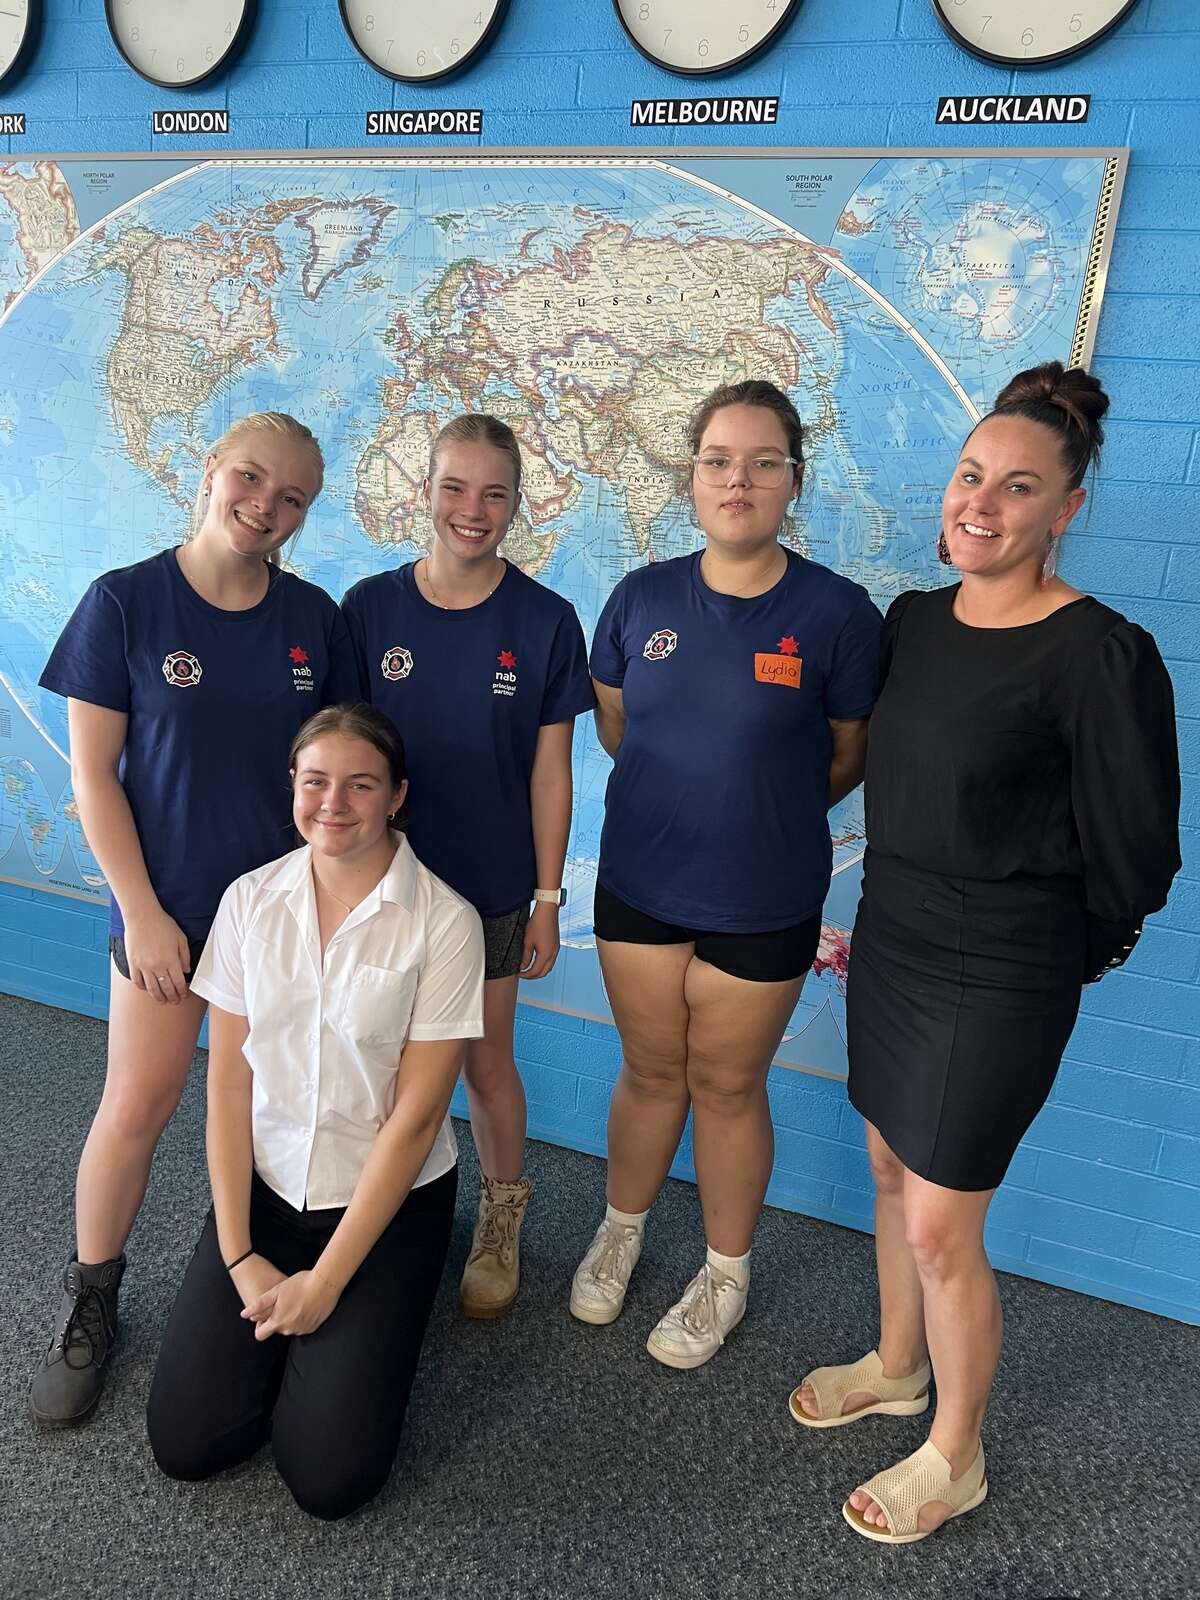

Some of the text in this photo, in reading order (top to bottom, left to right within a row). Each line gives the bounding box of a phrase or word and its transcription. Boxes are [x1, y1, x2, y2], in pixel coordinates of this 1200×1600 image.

[474, 11, 482, 26] 4
[638, 3, 650, 21] 8
[224, 22, 232, 36] 4
[365, 15, 375, 31] 8
[981, 15, 993, 33] 7
[1068, 13, 1082, 33] 5
[130, 26, 140, 41] 8
[663, 29, 673, 46] 7
[737, 24, 749, 42] 5
[1021, 27, 1034, 46] 6
[205, 47, 214, 61] 5
[386, 39, 395, 55] 7
[450, 38, 460, 54] 5
[698, 39, 709, 57] 6
[176, 56, 185, 73] 6
[416, 50, 426, 66] 6
[631, 99, 777, 124] MELBOURNE
[938, 97, 1087, 122] AUCKLAND
[153, 112, 228, 132] LONDON
[367, 112, 481, 134] SINGAPORE
[785, 174, 833, 182] SOUTH POLAR
[324, 223, 363, 232] GREENLAND
[543, 288, 721, 309] RUSSIA
[115, 367, 205, 388] UNITED STATES
[859, 379, 912, 393] NORTH
[883, 437, 946, 449] PACIFIC
[628, 476, 665, 484] INDIA
[292, 666, 312, 677] nab
[495, 671, 517, 682] nab
[761, 659, 797, 681] Lydia
[492, 683, 517, 691] principal
[493, 688, 514, 697] partner
